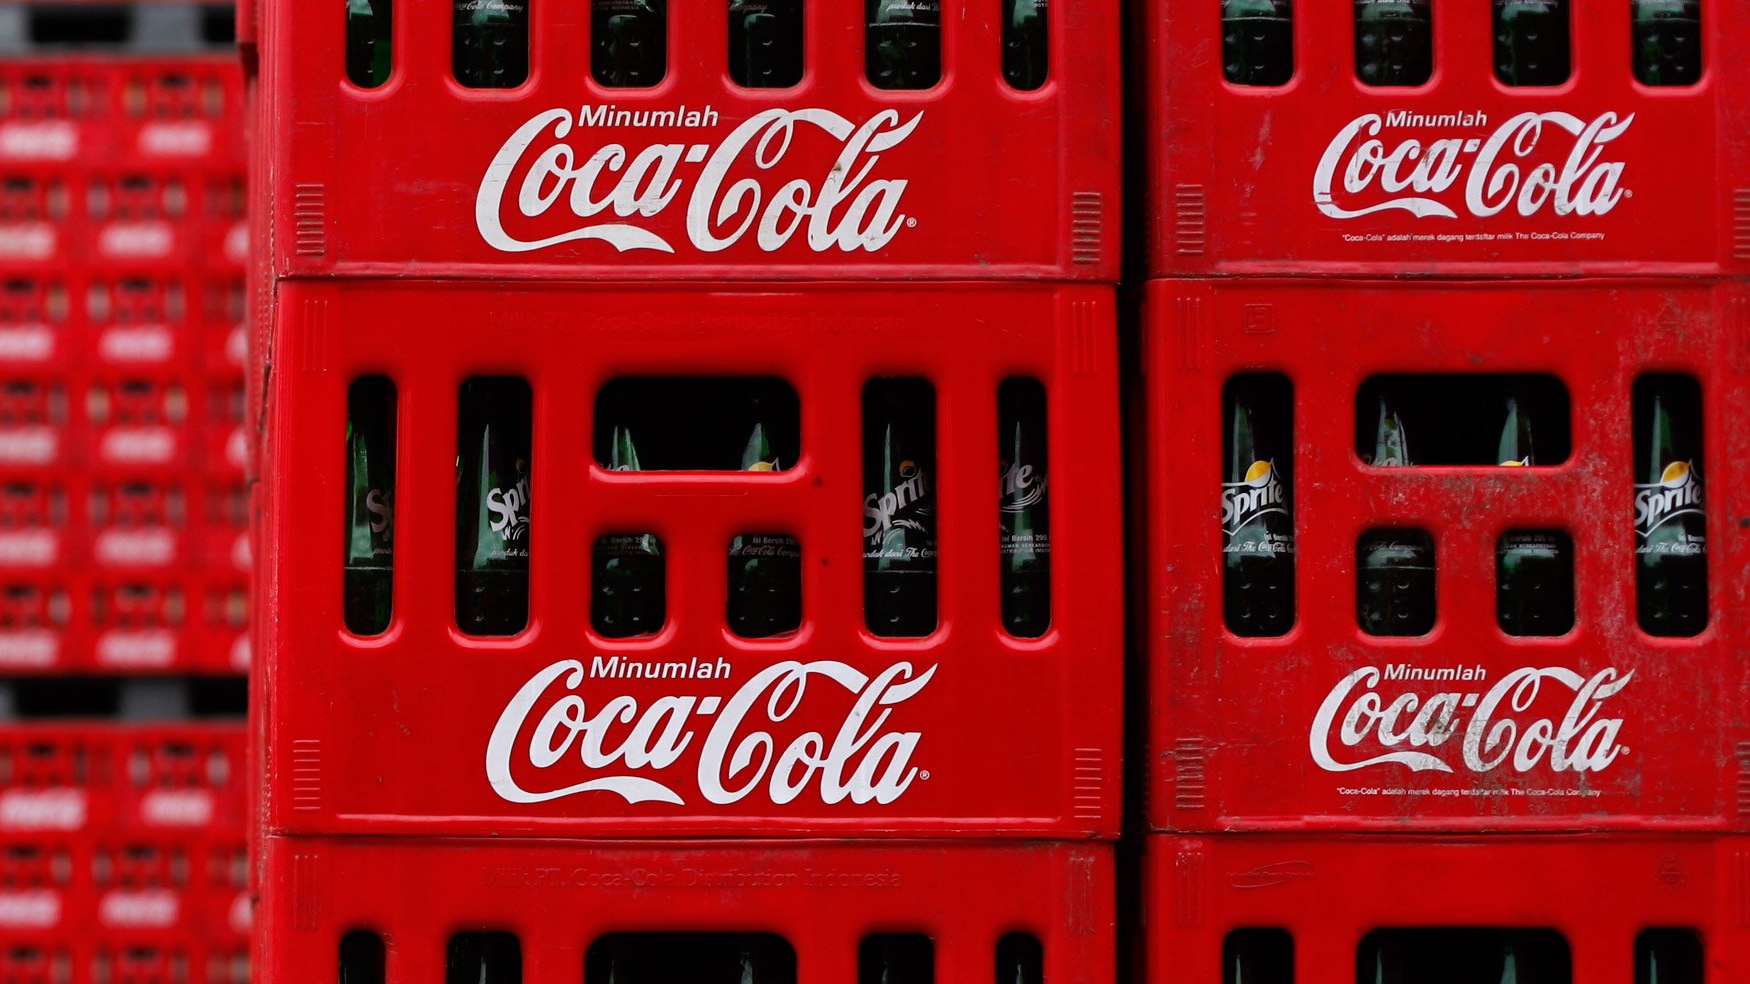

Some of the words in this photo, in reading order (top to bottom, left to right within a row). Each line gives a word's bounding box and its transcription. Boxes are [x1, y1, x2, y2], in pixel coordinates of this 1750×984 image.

[579, 105, 718, 126] Minumlah
[1386, 111, 1487, 126] Minumlah
[1437, 234, 1464, 242] dagang
[1570, 232, 1605, 240] Company
[590, 656, 730, 678] Minumlah
[1384, 664, 1486, 680] Minumlah
[1432, 788, 1459, 797] dagang
[1511, 788, 1525, 796] The
